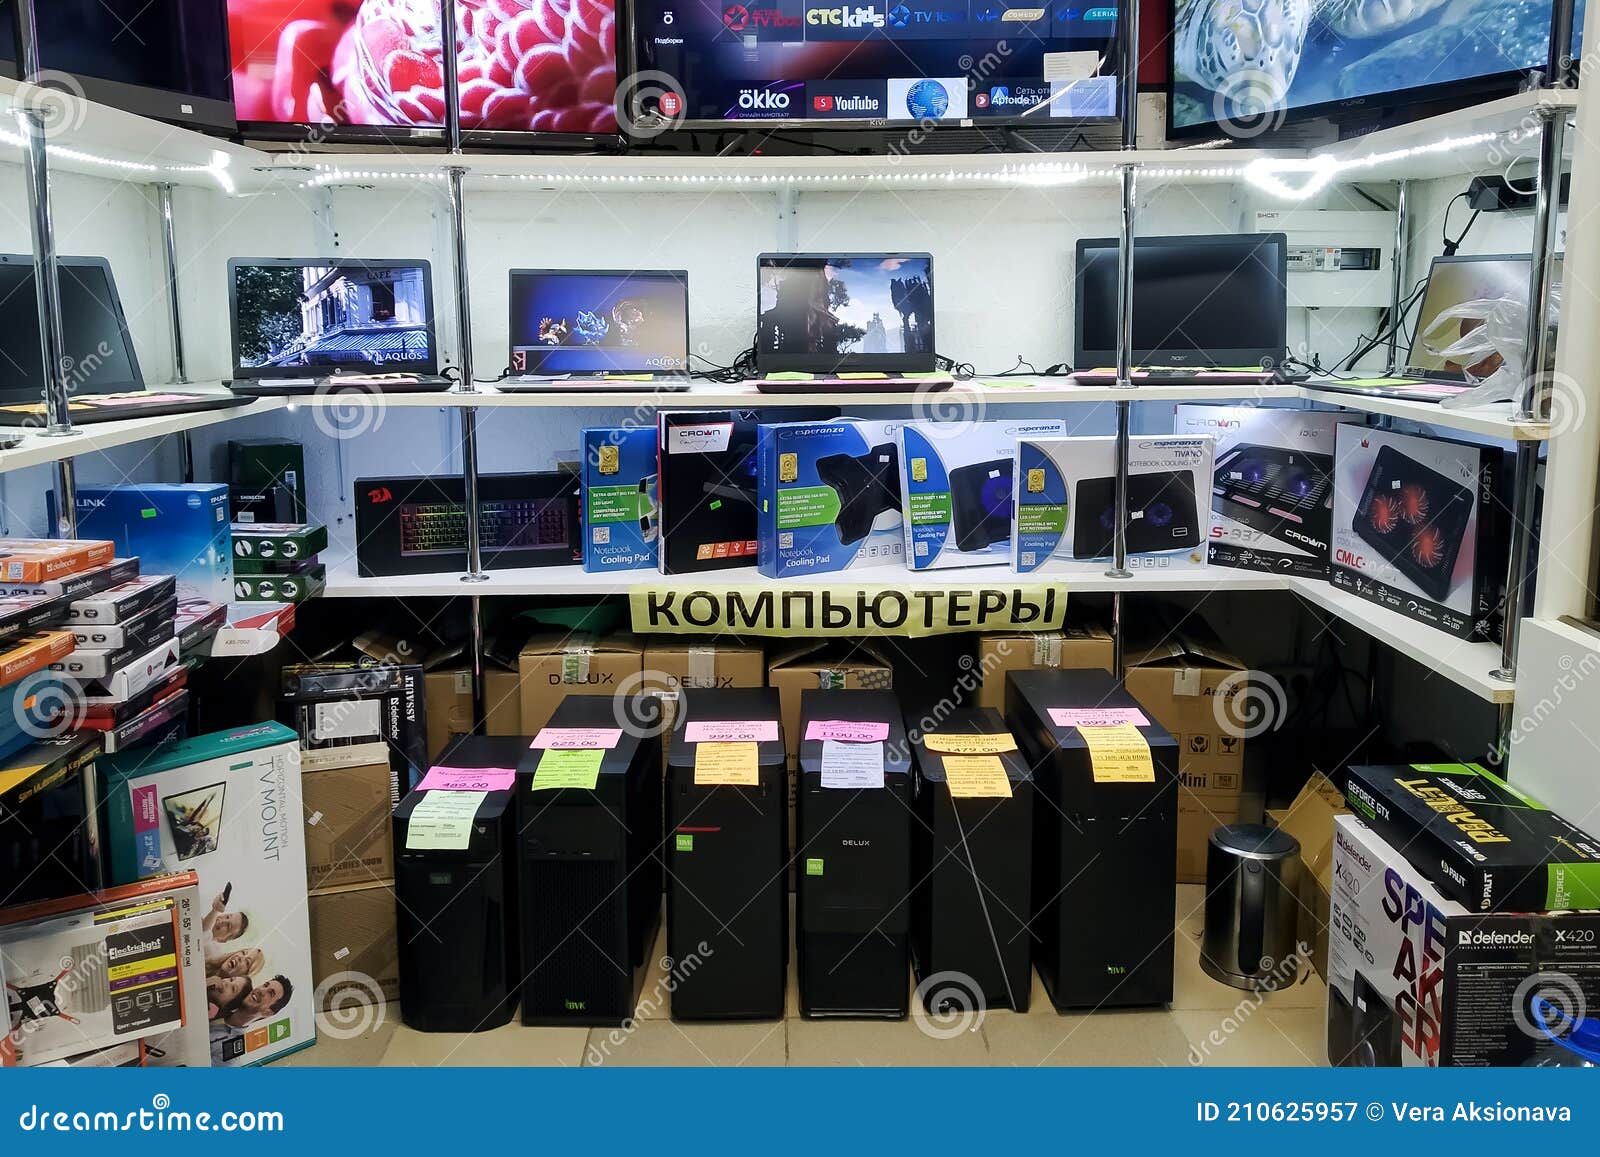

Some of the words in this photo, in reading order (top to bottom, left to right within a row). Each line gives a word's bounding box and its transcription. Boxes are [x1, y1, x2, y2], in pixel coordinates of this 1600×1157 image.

[655, 37, 684, 45] Подборки
[835, 96, 879, 111] YouTube
[645, 358, 682, 367] AQUOS
[795, 427, 844, 436] esperanza
[1017, 425, 1061, 433] esperanza
[1174, 450, 1202, 458] TIVANO
[1285, 529, 1327, 550] CROWN
[594, 546, 631, 555] Notebook
[601, 555, 633, 564] Cooling
[634, 553, 650, 562] Pad
[779, 547, 814, 558] Notebook
[785, 557, 813, 568] Cooling
[815, 555, 830, 565] Pad
[647, 587, 1057, 629] КОМПЬЮТЕРЫ
[405, 675, 416, 723] ASSAULT
[391, 704, 400, 740] defender
[259, 755, 275, 784] TV
[1348, 780, 1375, 809] GEFORCE
[1376, 802, 1390, 821] GTX
[261, 789, 280, 861] MOUNT
[279, 813, 289, 849] MOTION
[1342, 838, 1372, 871] defender
[1336, 861, 1360, 896] X420
[1448, 866, 1467, 887] PALIT
[1482, 872, 1493, 899] PALIT
[1554, 869, 1565, 908] GEFORCE
[1472, 930, 1535, 945] defender
[1555, 930, 1595, 942] X420
[109, 937, 162, 960] Electriclight
